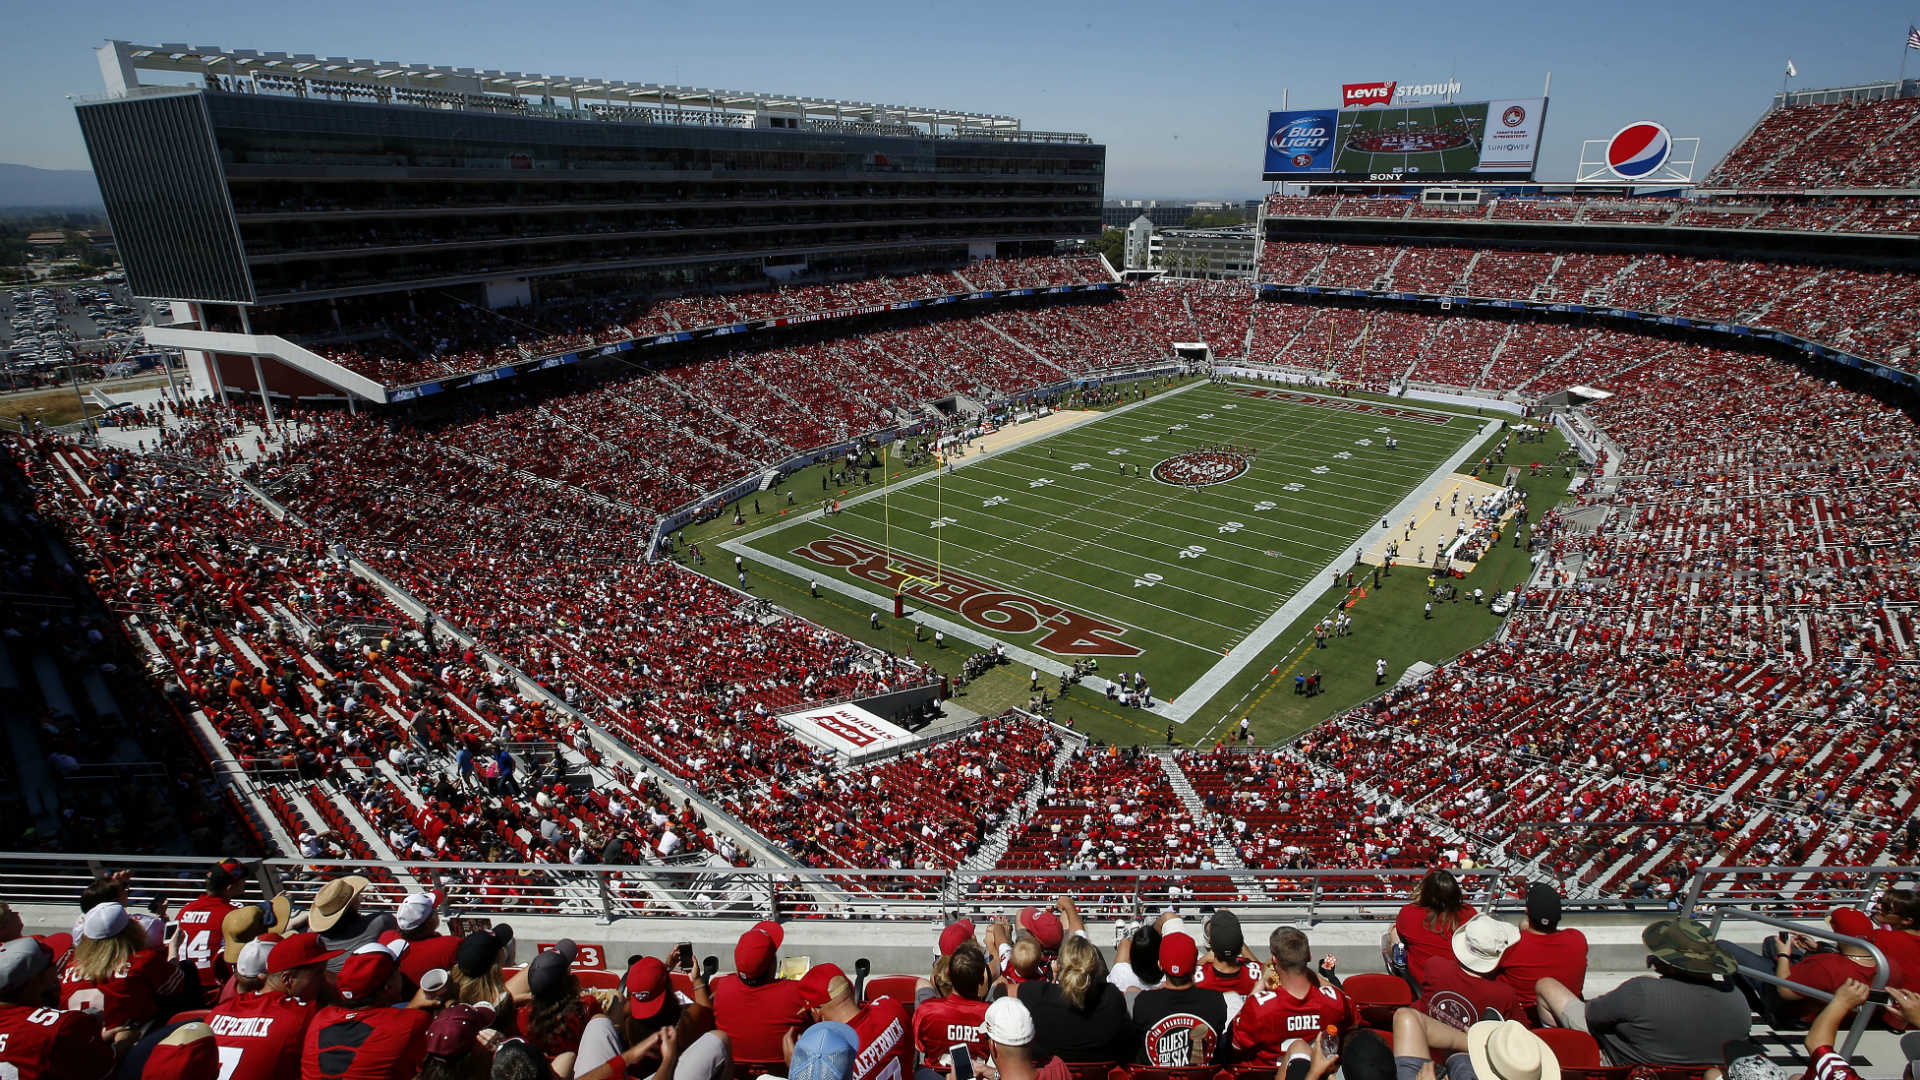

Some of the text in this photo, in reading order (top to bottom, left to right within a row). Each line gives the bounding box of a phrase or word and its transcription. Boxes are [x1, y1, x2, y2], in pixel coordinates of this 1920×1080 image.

[1396, 82, 1462, 97] STADIUM
[1287, 127, 1326, 138] BUD
[1279, 137, 1330, 148] LIGHT
[1370, 173, 1403, 181] SONY
[787, 314, 820, 325] WELCOME
[858, 306, 885, 315] STADIUM
[789, 533, 1147, 658] 49ERS
[181, 911, 211, 924] SMITH
[1287, 1015, 1321, 1031] GORE
[946, 1024, 980, 1043] GORE
[1159, 1029, 1191, 1054] QUEST
[1159, 1052, 1171, 1063] FOR
[1171, 1046, 1190, 1067] SIX
